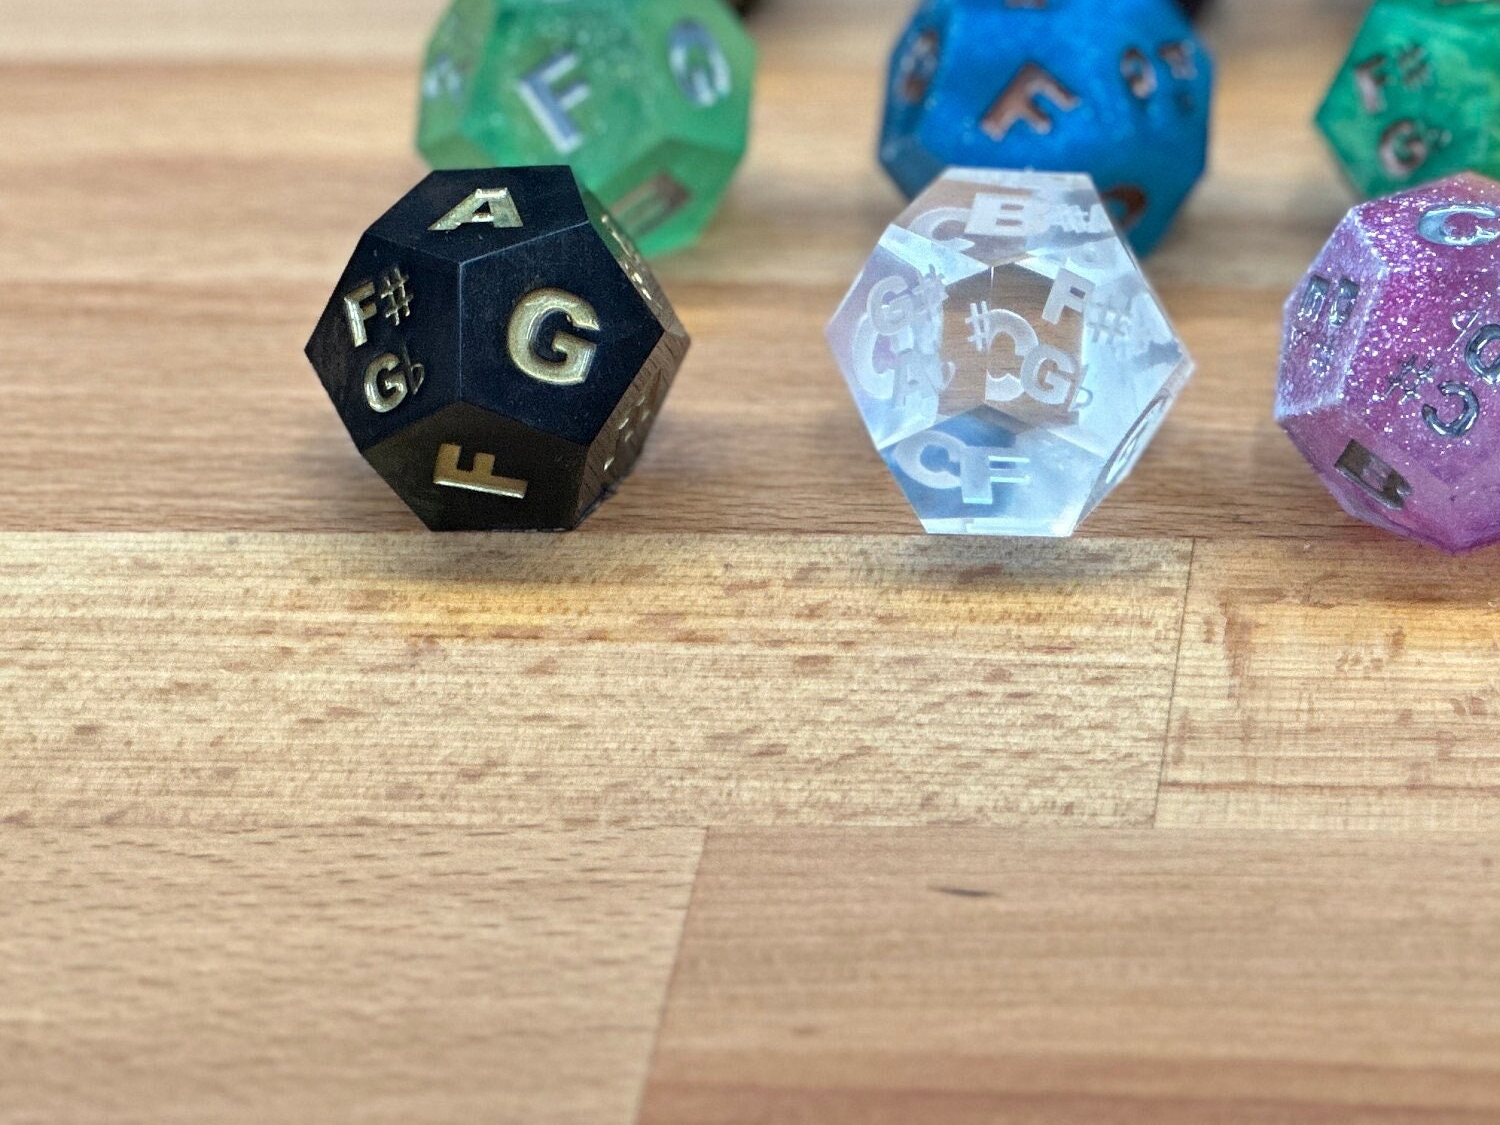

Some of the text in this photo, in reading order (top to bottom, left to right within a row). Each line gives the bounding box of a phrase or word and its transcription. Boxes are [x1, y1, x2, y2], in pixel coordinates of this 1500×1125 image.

[517, 48, 591, 154] F
[979, 61, 1081, 142] F
[427, 186, 524, 232] A
[343, 267, 415, 347] F#
[507, 286, 600, 385] G
[432, 442, 528, 499] F
